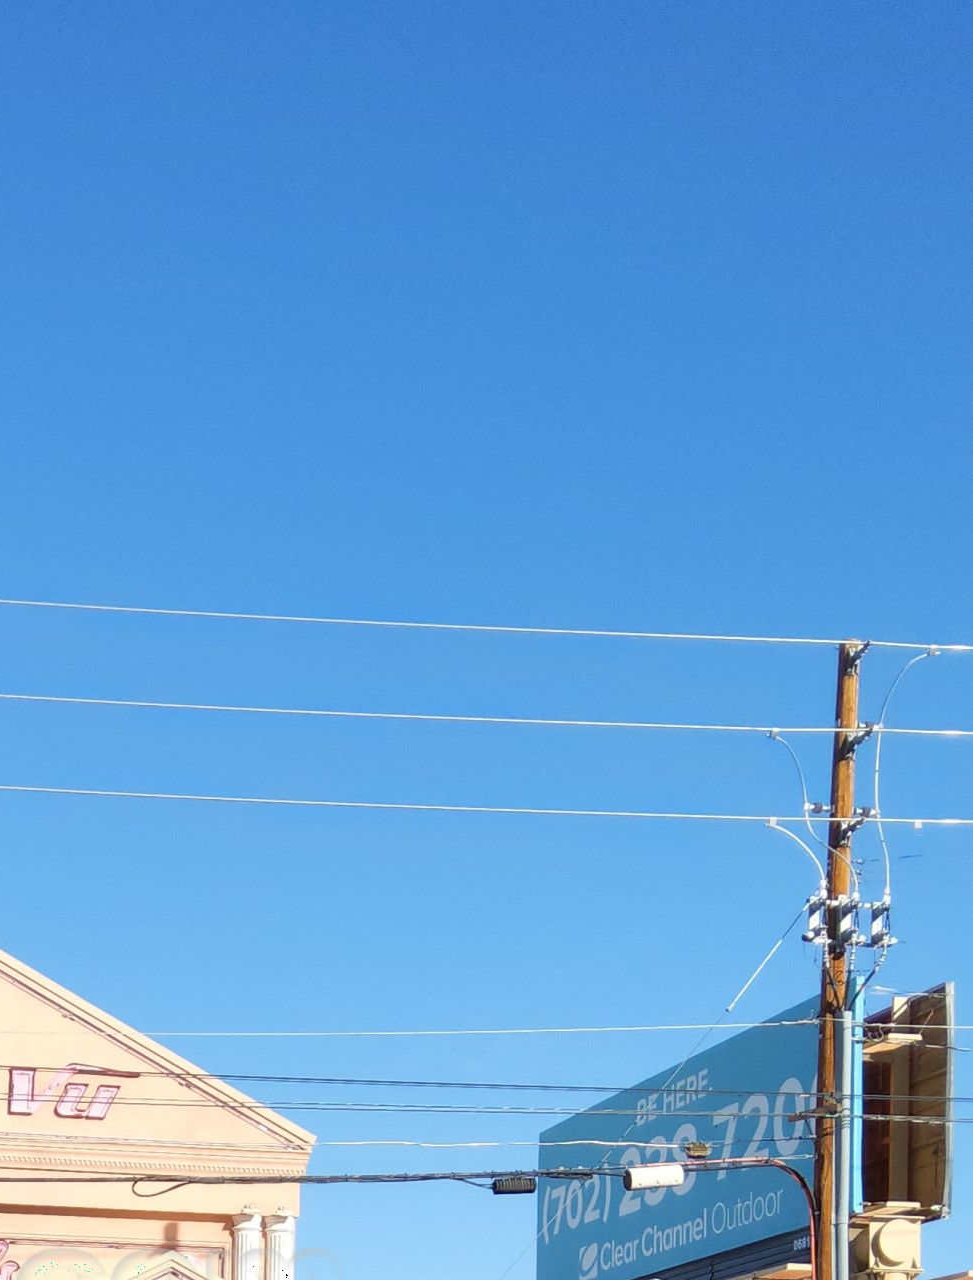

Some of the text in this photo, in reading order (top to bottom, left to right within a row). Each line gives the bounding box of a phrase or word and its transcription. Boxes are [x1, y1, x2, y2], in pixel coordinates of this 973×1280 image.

[7, 1062, 141, 1120] Vu
[662, 1067, 713, 1114] HERE.
[600, 1188, 784, 1271] Clear Channel Outdoor
